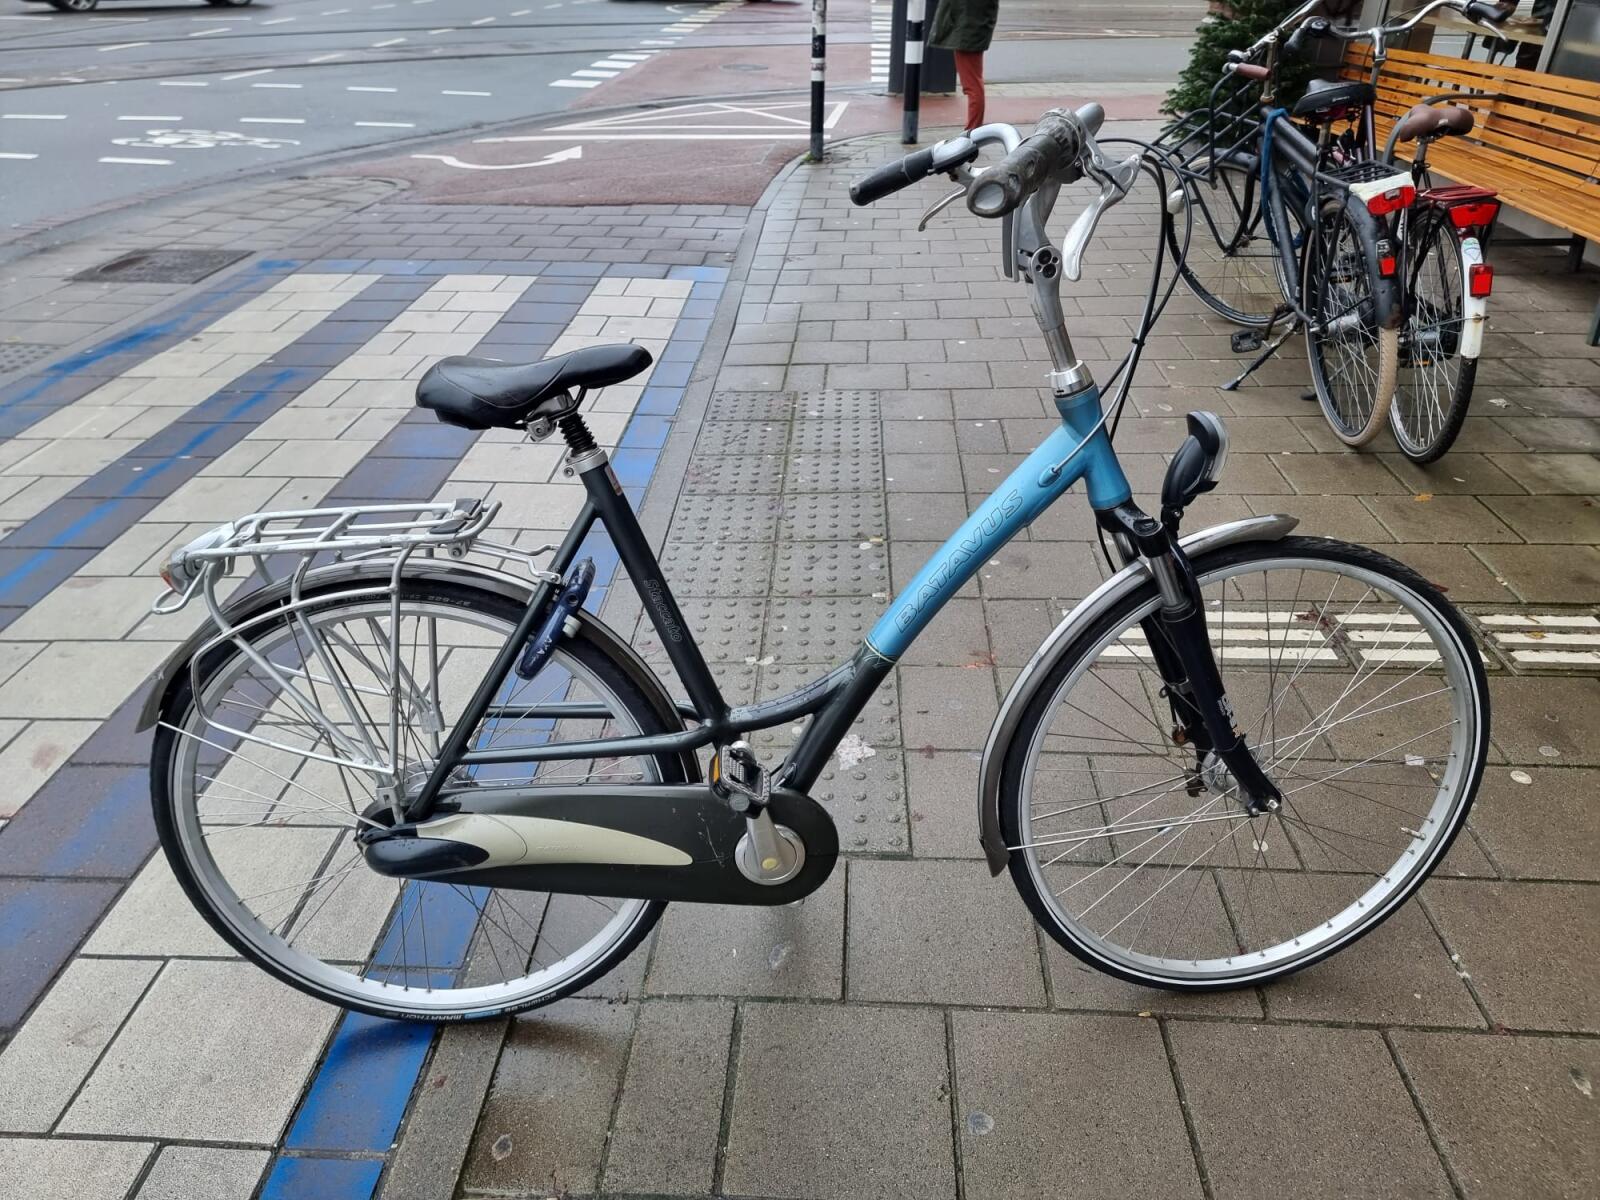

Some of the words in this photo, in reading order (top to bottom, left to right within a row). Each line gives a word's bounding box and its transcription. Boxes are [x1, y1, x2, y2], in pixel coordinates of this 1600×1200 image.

[894, 489, 1024, 634] BATAVUS
[643, 579, 683, 642] Staccato
[400, 1012, 463, 1021] MARATHON
[503, 992, 558, 1013] SCHWALBE
